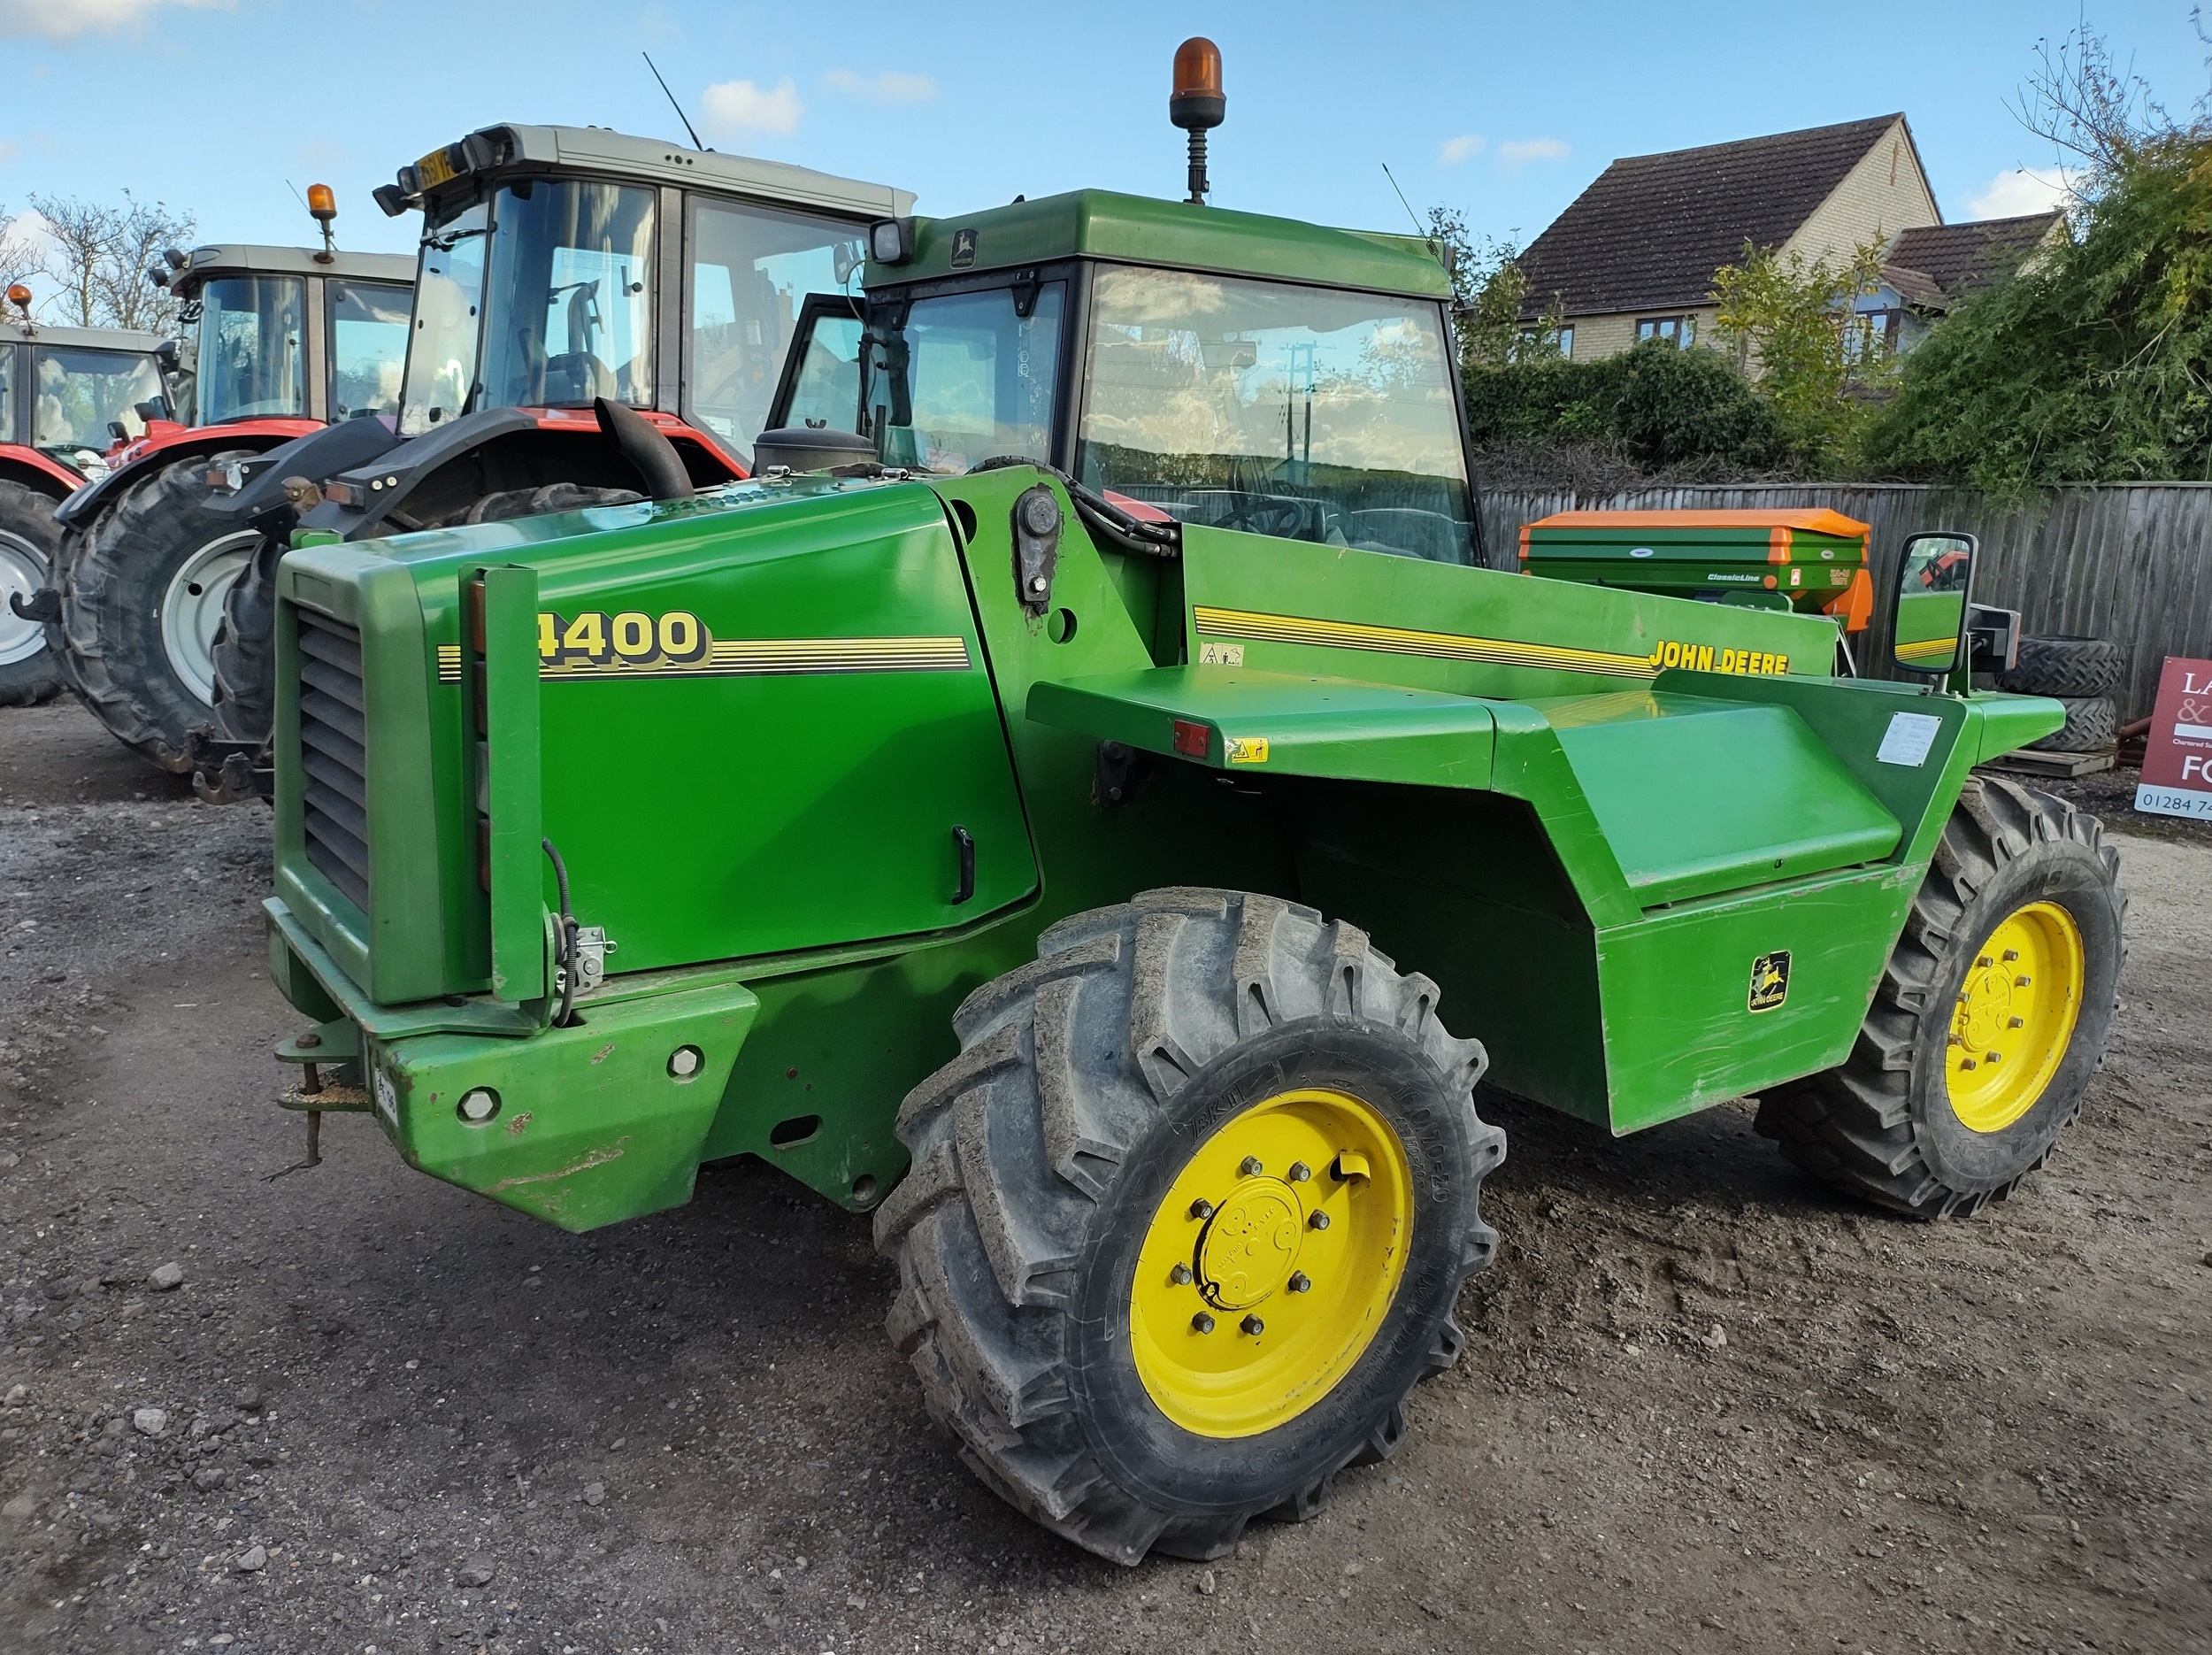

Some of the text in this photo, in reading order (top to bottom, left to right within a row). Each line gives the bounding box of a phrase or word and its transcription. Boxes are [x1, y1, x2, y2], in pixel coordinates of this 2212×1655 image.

[538, 611, 710, 670] 4400
[1648, 640, 1789, 675] JOHN DEERE
[2177, 697, 2210, 723] &
[2172, 738, 2204, 748] Chartered
[2143, 793, 2191, 812] 01284
